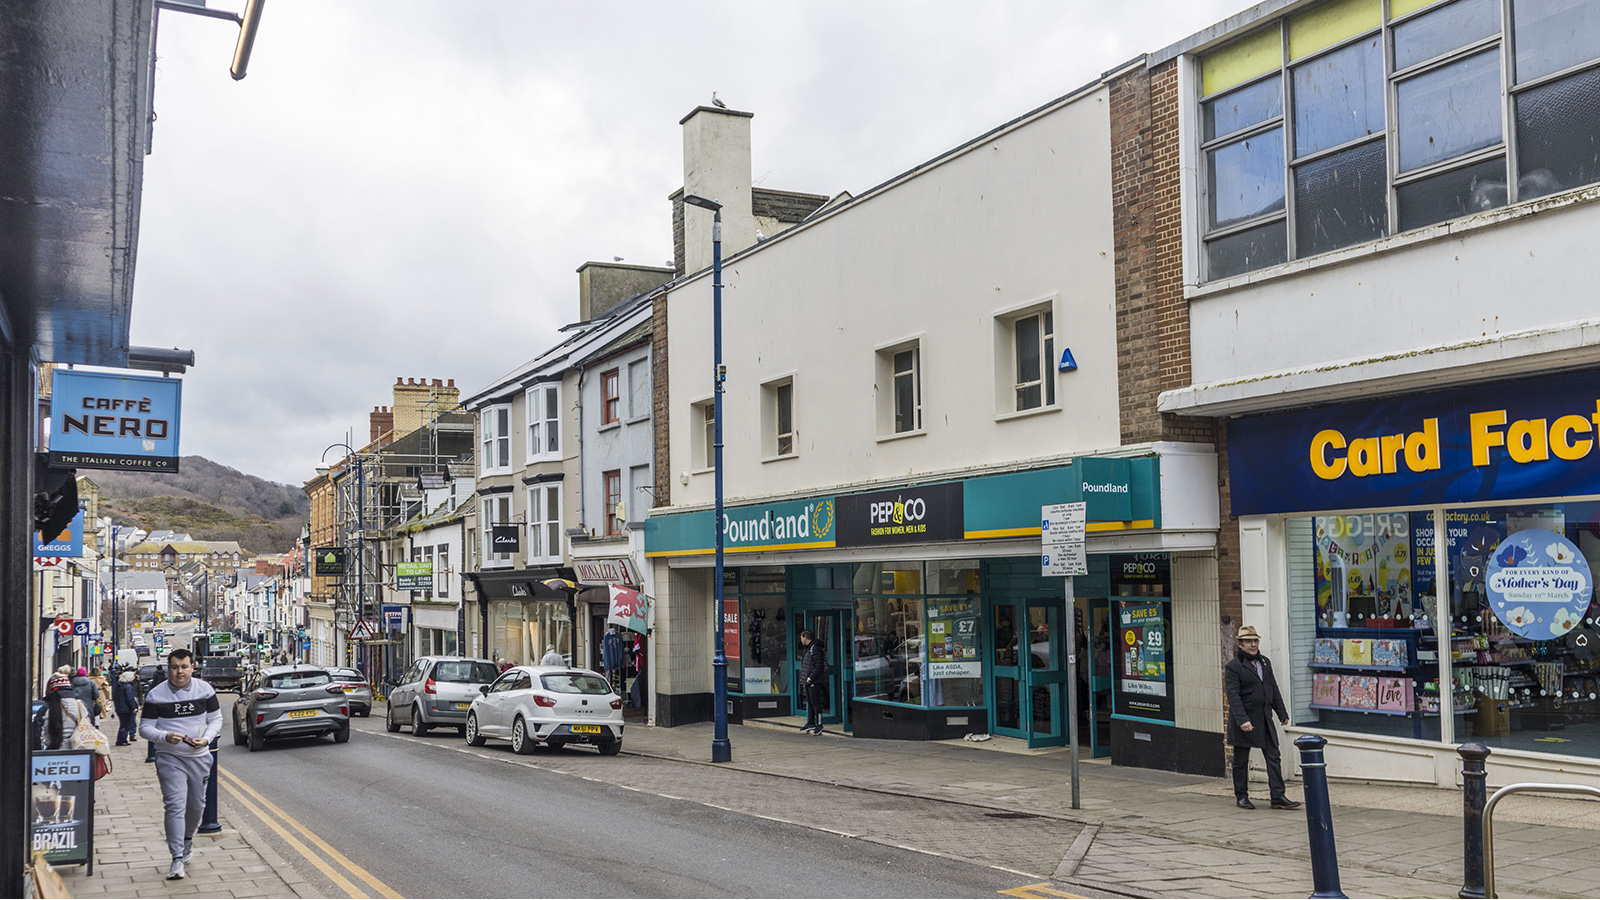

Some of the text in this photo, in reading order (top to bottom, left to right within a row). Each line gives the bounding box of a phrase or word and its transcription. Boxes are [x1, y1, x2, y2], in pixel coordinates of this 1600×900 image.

[82, 397, 151, 413] CAFFÈ
[62, 412, 168, 440] NERO
[1310, 417, 1441, 480] Card
[81, 457, 116, 465] ITALIAN
[120, 459, 151, 467] COFFEE
[1082, 482, 1128, 493] Poundland
[871, 498, 926, 524] PEP&CO
[1416, 528, 1468, 537] SHOP YOUR
[1416, 547, 1424, 555] IN
[1417, 557, 1431, 565] FEW
[1495, 577, 1579, 591] Mother's Day
[940, 604, 958, 613] SAVE
[1132, 608, 1157, 619] SAVE £5
[724, 613, 737, 623] SALE
[959, 620, 974, 632] £7
[1148, 631, 1162, 646] £9
[1315, 681, 1335, 700] Love
[1380, 685, 1402, 705] Love
[34, 766, 80, 776] NERO
[33, 831, 78, 851] BRAZIL
